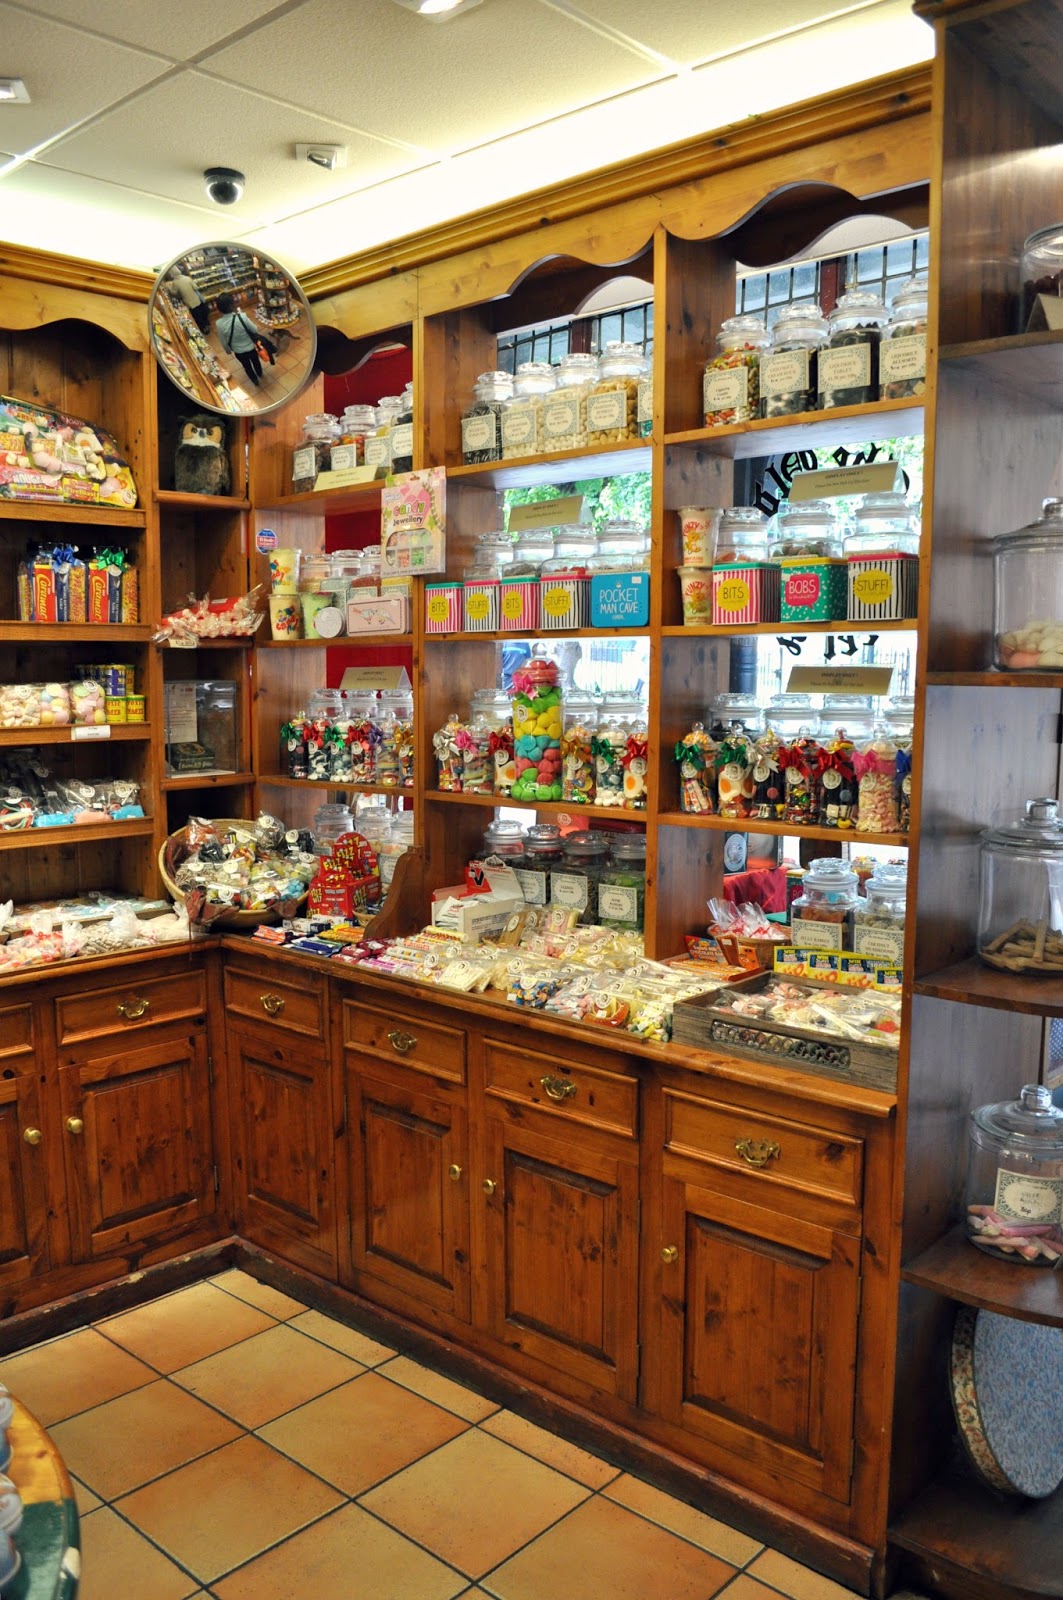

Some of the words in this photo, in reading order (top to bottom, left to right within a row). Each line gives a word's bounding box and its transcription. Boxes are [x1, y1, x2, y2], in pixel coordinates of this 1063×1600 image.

[393, 501, 425, 516] candy
[788, 580, 816, 594] BOBS
[856, 579, 889, 592] STUFF!
[35, 573, 51, 619] Caramac
[92, 575, 106, 619] Caramac
[600, 588, 639, 602] POCKET
[723, 586, 745, 599] BITS
[432, 601, 446, 612] BITS
[469, 600, 487, 610] STUFF!
[505, 598, 520, 609] BITS
[545, 596, 569, 606] STUFF!
[600, 603, 617, 613] MAN
[620, 602, 639, 613] CAVE
[470, 868, 485, 887] V
